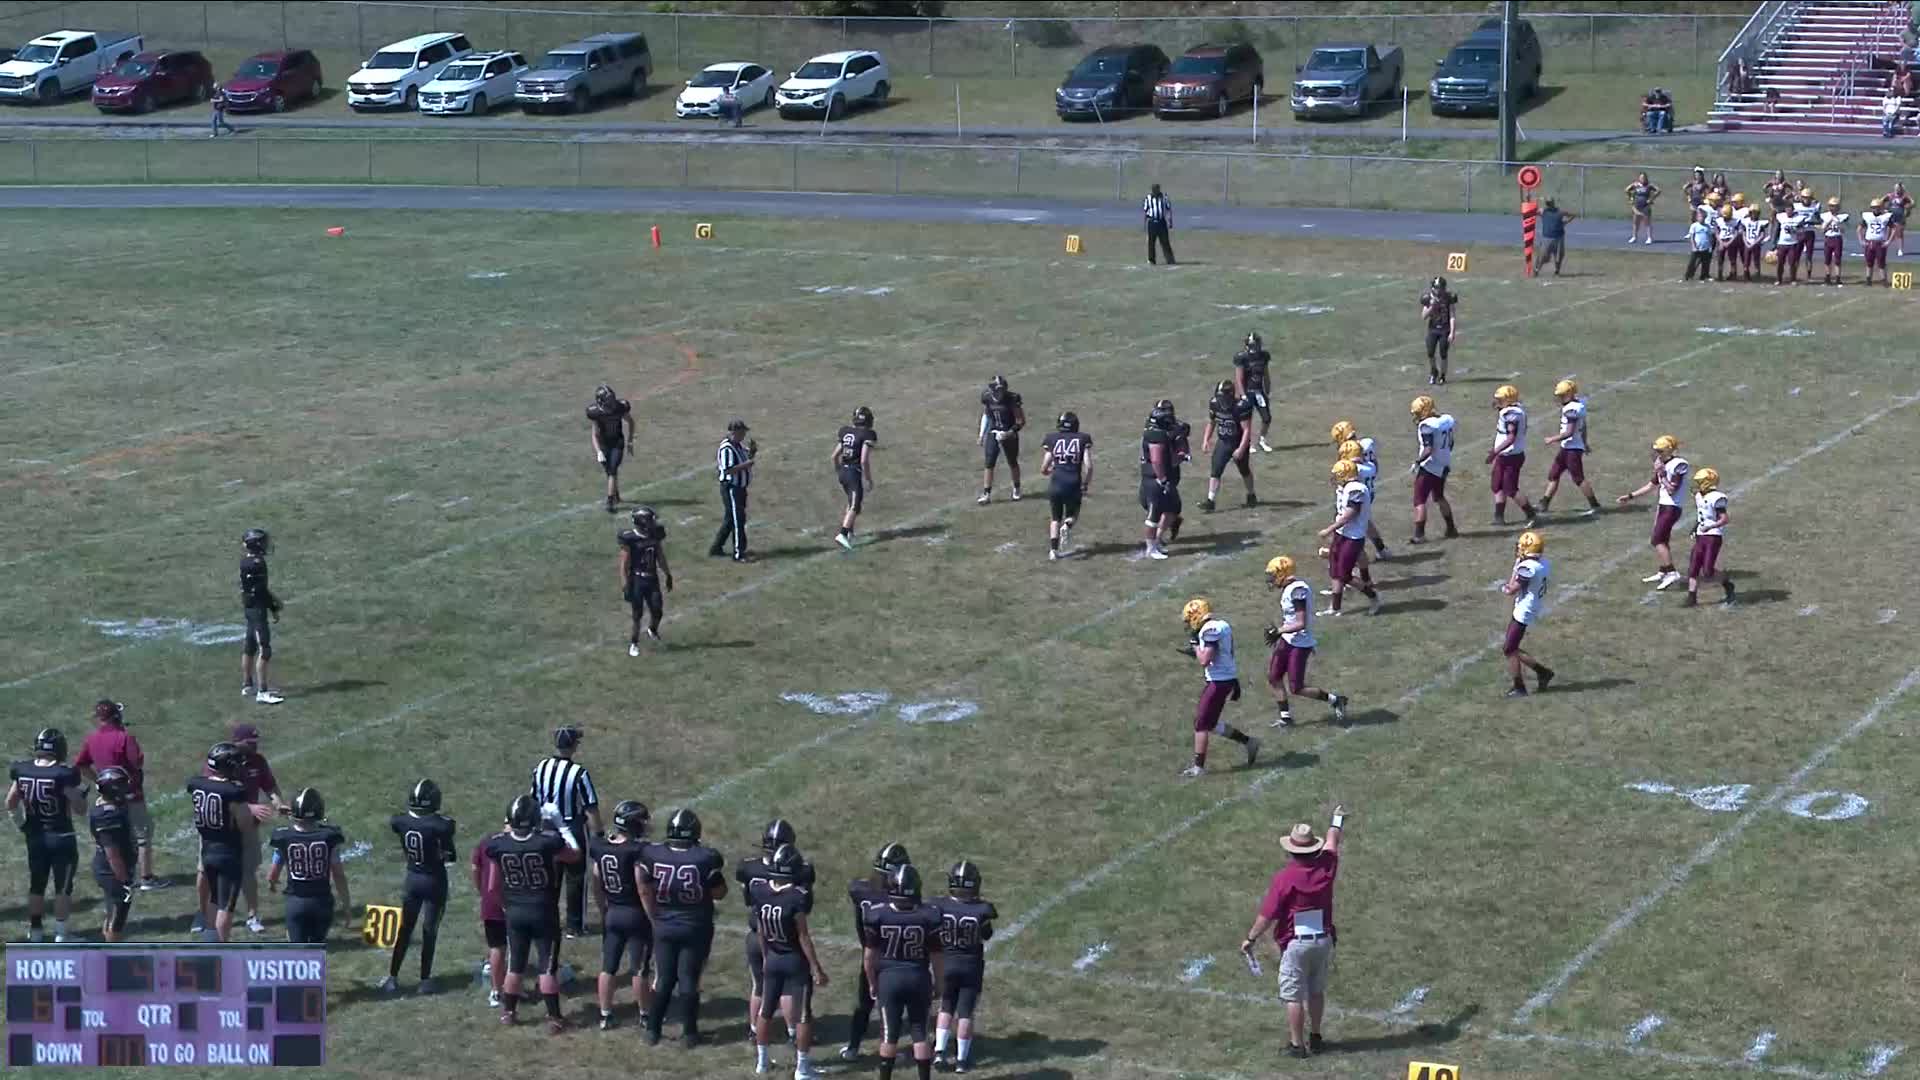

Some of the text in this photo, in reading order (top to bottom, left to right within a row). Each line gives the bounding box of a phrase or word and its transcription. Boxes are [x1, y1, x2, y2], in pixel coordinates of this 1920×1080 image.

[698, 225, 709, 238] G
[1068, 236, 1078, 250] 10
[1449, 255, 1463, 269] 20
[1894, 273, 1910, 288] 30
[1052, 437, 1081, 464] 44
[17, 777, 57, 816] 75
[192, 789, 224, 830] 30
[287, 841, 330, 881] 88
[404, 830, 425, 866] 9
[500, 852, 549, 889] 66
[601, 853, 623, 893] 6
[652, 862, 704, 904] 73
[366, 907, 399, 946] 30
[760, 903, 788, 943] 11
[880, 925, 925, 959] 72
